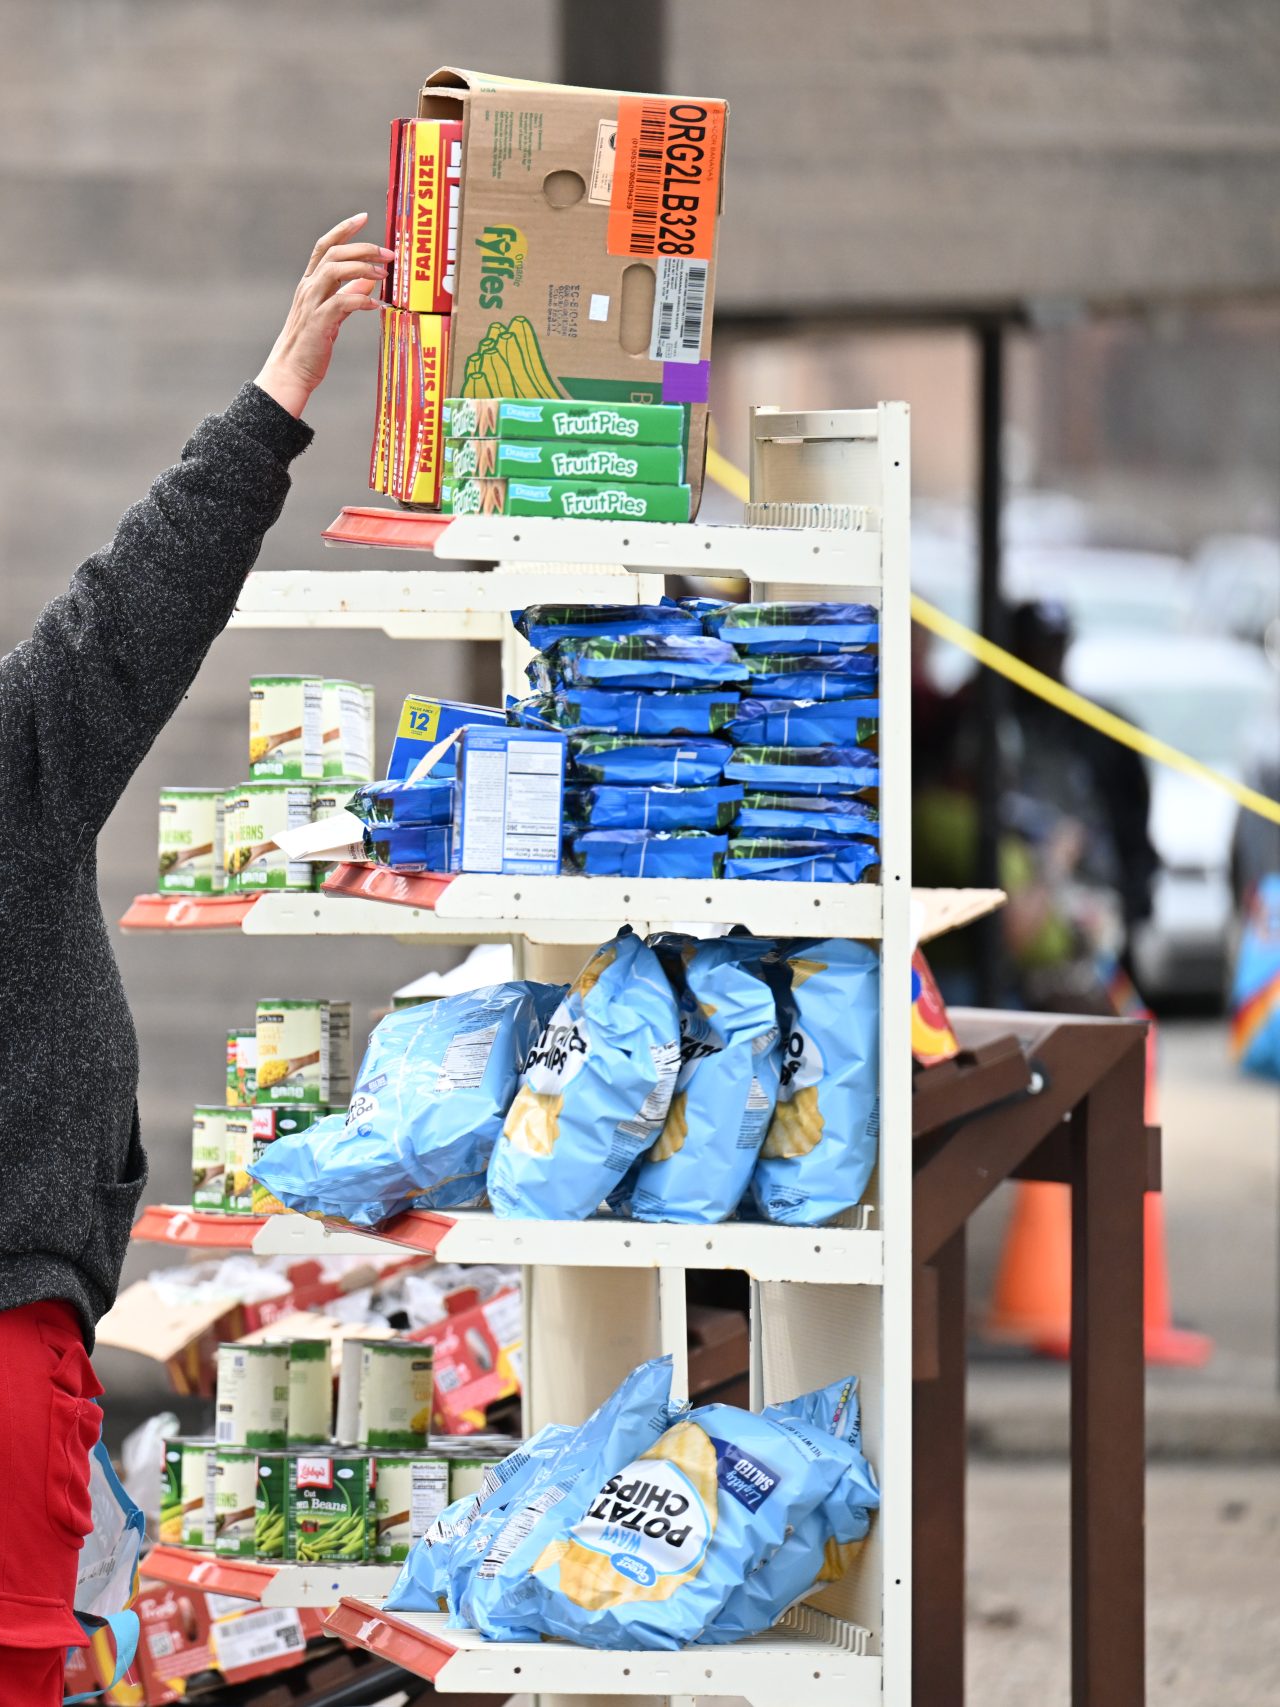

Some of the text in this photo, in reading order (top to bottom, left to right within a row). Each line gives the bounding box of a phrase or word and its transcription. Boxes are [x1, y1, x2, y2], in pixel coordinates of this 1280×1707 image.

[657, 104, 708, 256] ORG2LB328
[415, 155, 434, 281] FAMILY SIZE
[513, 253, 524, 289] Organic
[419, 346, 437, 473] FAMILY SIZE
[410, 711, 430, 732] 12
[726, 1470, 762, 1504] Lightly
[734, 1459, 774, 1491] SALTED
[303, 1489, 317, 1498] Cut
[311, 1498, 348, 1512] Beans
[600, 1474, 690, 1518] CHIPS
[581, 1497, 694, 1548] POTAT
[600, 1525, 642, 1553] WAVY
[616, 1559, 650, 1584] Great
[622, 1555, 648, 1571] Value
